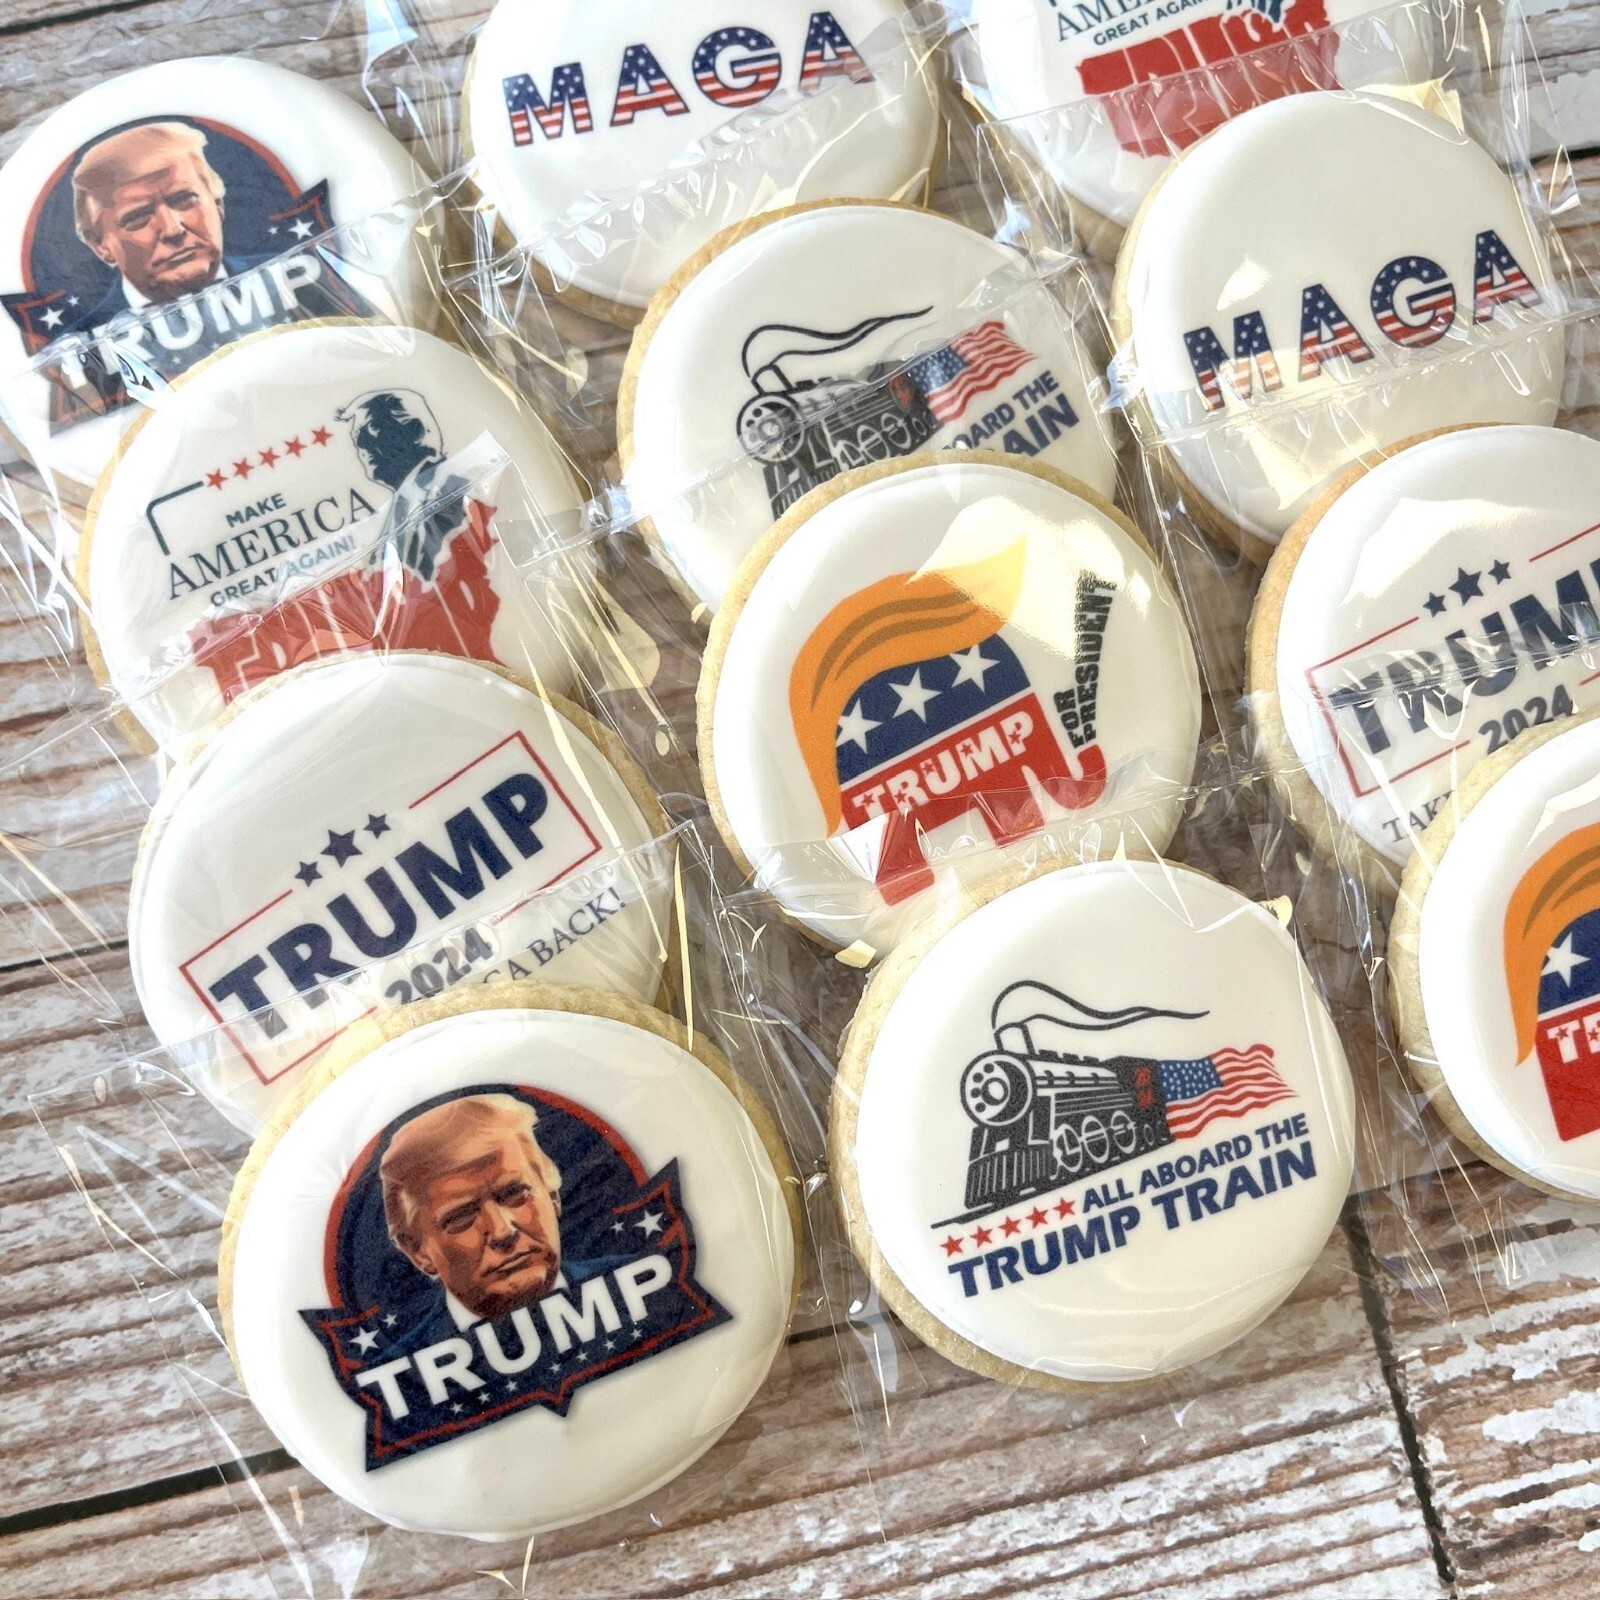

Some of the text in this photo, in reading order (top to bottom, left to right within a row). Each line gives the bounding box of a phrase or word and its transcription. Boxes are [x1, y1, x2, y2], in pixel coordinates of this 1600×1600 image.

[501, 11, 876, 147] MAGA
[1093, 13, 1150, 46] GREAT
[55, 253, 322, 390] TRUMP
[1183, 229, 1543, 412] MAGA
[942, 370, 1060, 452] OARD THE
[1003, 393, 1080, 457] AIN
[169, 488, 377, 600] AMERICA
[225, 493, 286, 528] MAKE
[210, 535, 357, 607] GREAT AGAIN!
[1074, 569, 1117, 743] PRESIDENT
[1328, 558, 1600, 754] TRUM
[852, 710, 1035, 823] TRUMP
[1053, 688, 1085, 749] FOR
[1478, 684, 1575, 755] 2024
[209, 773, 549, 1040] TRUMP
[527, 887, 626, 967] BACK!
[385, 927, 494, 1005] 2024
[1083, 1112, 1310, 1214] ALL ABOARD THE
[948, 1140, 1317, 1298] TRUMP TRAIN
[356, 1253, 673, 1420] TRUMP
